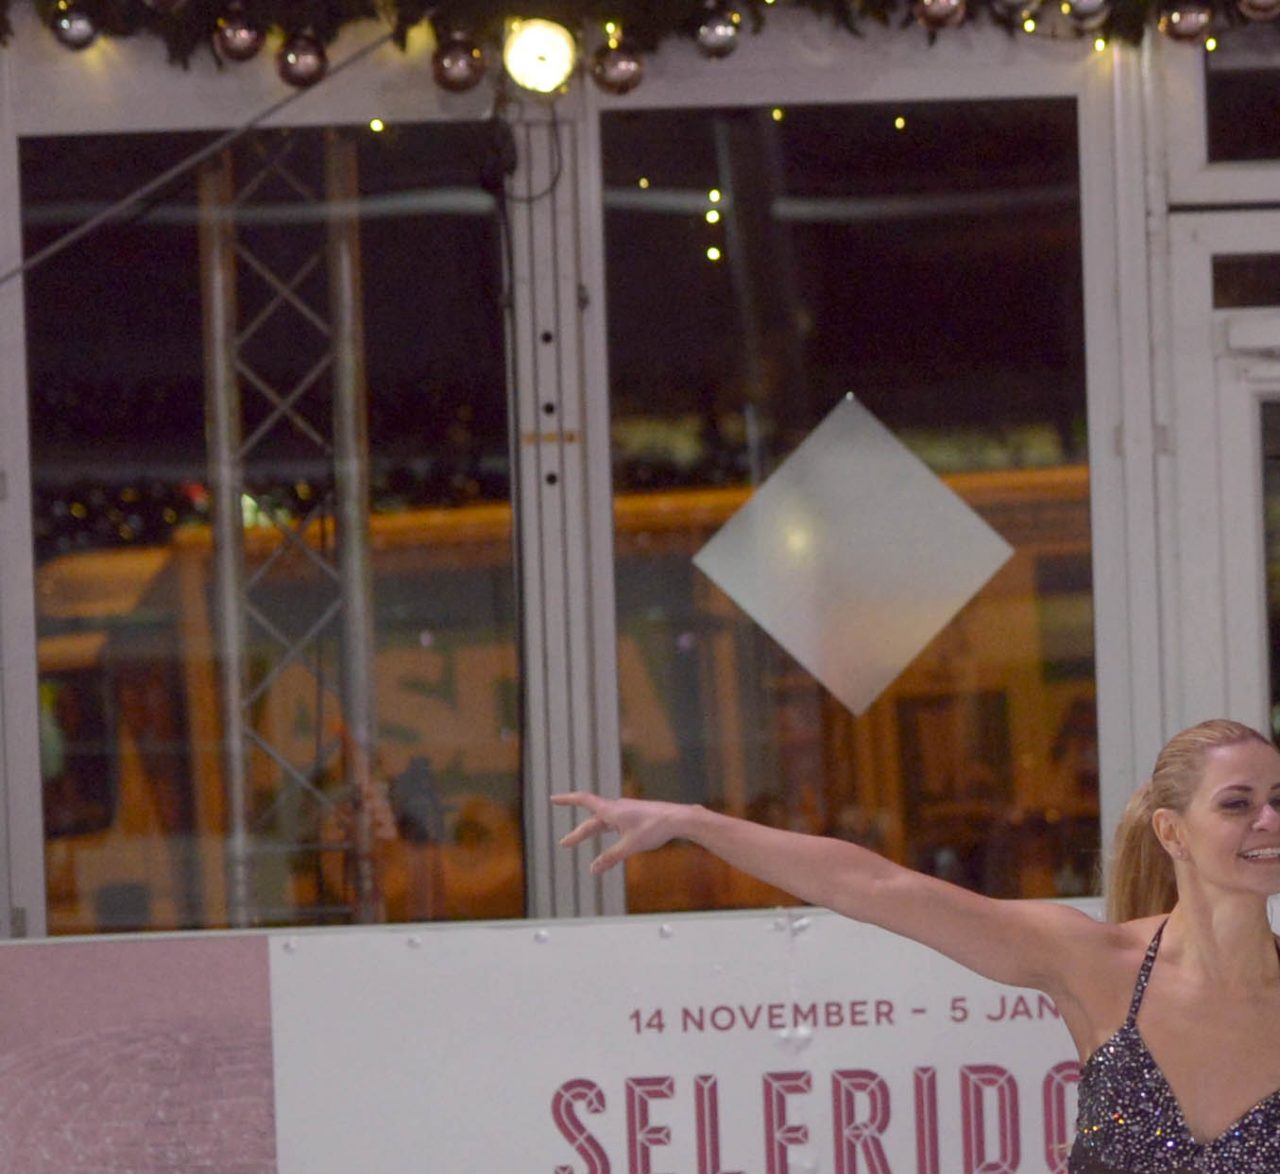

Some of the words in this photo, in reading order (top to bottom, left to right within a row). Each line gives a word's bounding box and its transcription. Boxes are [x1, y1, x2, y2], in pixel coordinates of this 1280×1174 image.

[630, 1007, 666, 1035] 14
[682, 1000, 895, 1032] NOVEMBER
[950, 996, 968, 1023] 5
